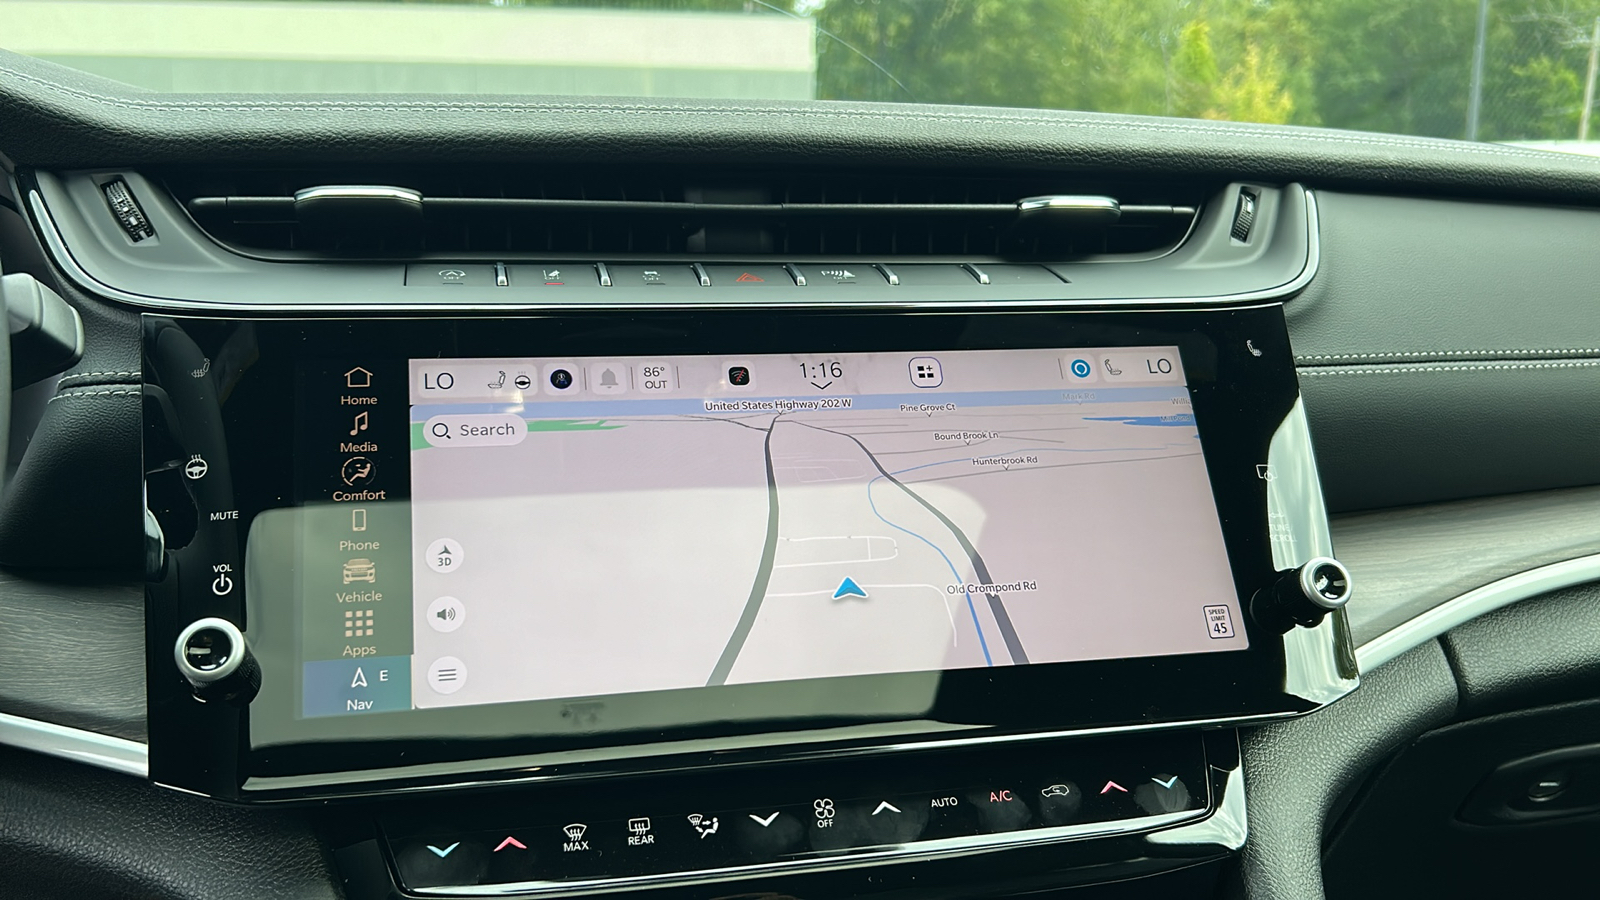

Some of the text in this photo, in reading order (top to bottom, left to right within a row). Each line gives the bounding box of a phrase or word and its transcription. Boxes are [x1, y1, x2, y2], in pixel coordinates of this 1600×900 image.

[799, 361, 843, 379] 1:16
[1146, 358, 1172, 374] LO
[643, 367, 665, 377] 86°
[424, 372, 454, 390] LO
[645, 380, 667, 389] OUT
[340, 395, 378, 405] Home
[705, 399, 852, 411] United States Highway 202 W
[900, 403, 956, 412] Pine Grove Ct
[460, 423, 515, 437] Search
[934, 431, 999, 441] Bound Brook Ln
[340, 442, 378, 452] Media
[972, 455, 1038, 466] Hunterbrook Rd
[333, 489, 386, 501] Comfort
[210, 510, 239, 521] MUTE
[339, 540, 380, 551] Phone
[437, 557, 452, 567] 3D
[212, 563, 233, 573] VOL
[946, 580, 1037, 595] Old Crompond Rd
[336, 590, 383, 603] Vehicle
[1213, 622, 1228, 634] 45
[342, 645, 377, 658] Apps
[379, 669, 389, 682] E
[346, 699, 374, 711] Nav
[989, 789, 1013, 802] A/C
[930, 796, 958, 808] AUTO
[817, 818, 834, 828] OFF
[628, 835, 655, 846] REAR
[563, 841, 590, 852] MAX
